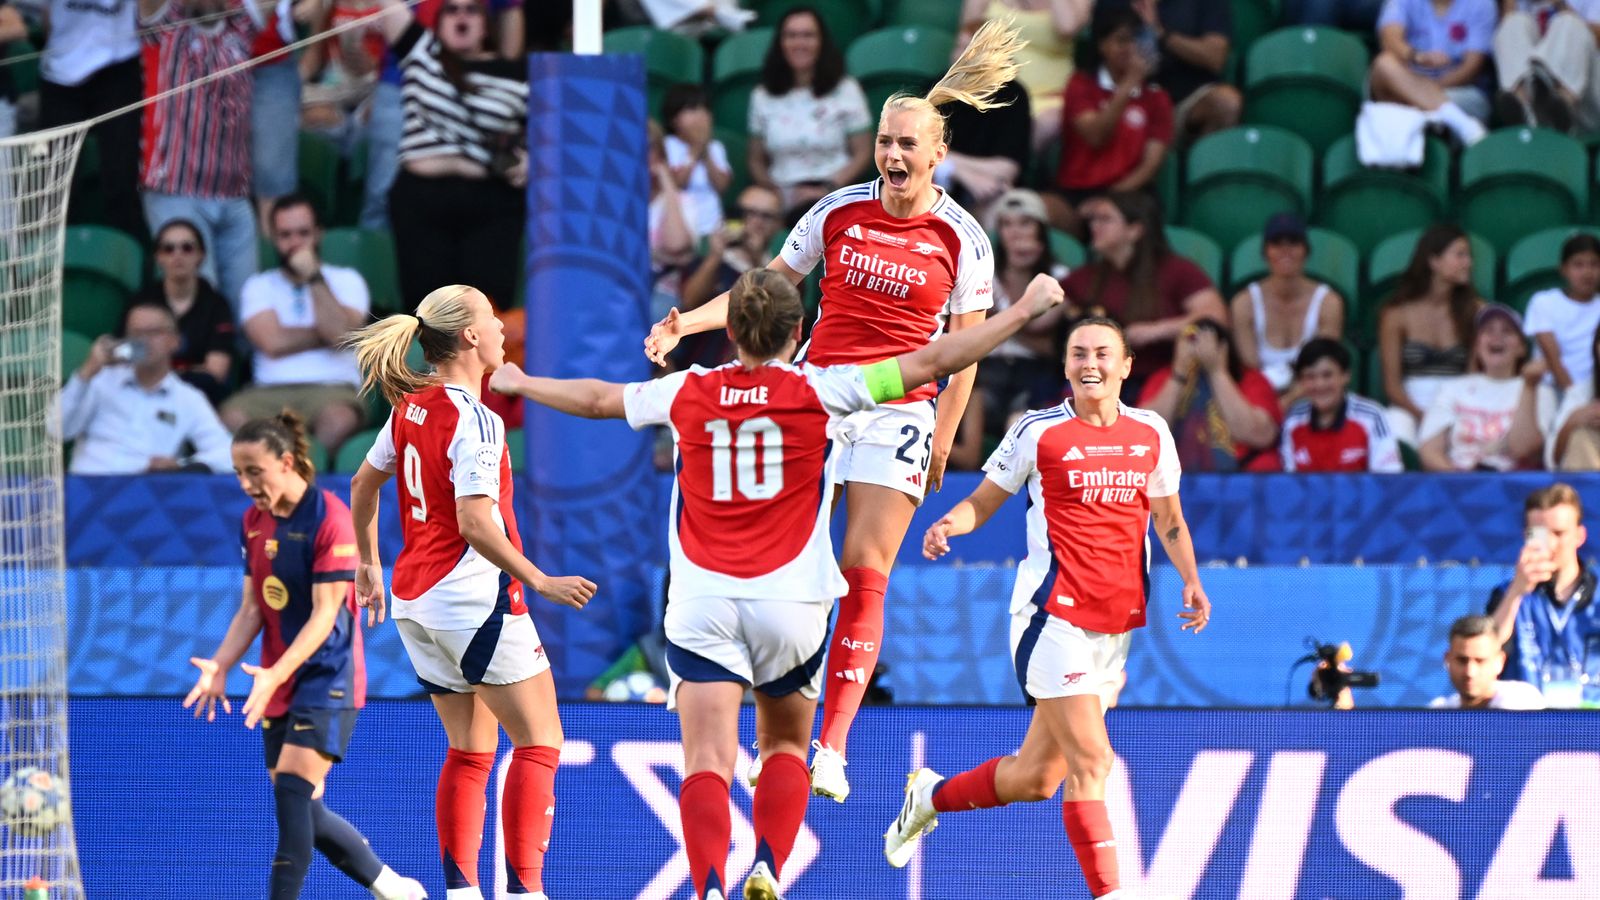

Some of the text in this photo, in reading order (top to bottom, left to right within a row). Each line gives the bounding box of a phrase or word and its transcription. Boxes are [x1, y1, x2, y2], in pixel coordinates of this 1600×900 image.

[840, 244, 927, 286] Emirates
[845, 269, 910, 299] FLY BETTER
[720, 385, 769, 406] LITTLE
[404, 402, 428, 426] EAD
[704, 416, 784, 502] 10
[404, 442, 427, 523] 9
[1067, 466, 1147, 489] Emirates
[1081, 487, 1137, 503] FLY BETTER
[841, 636, 875, 652] AFC
[1103, 748, 1600, 900] VISA
